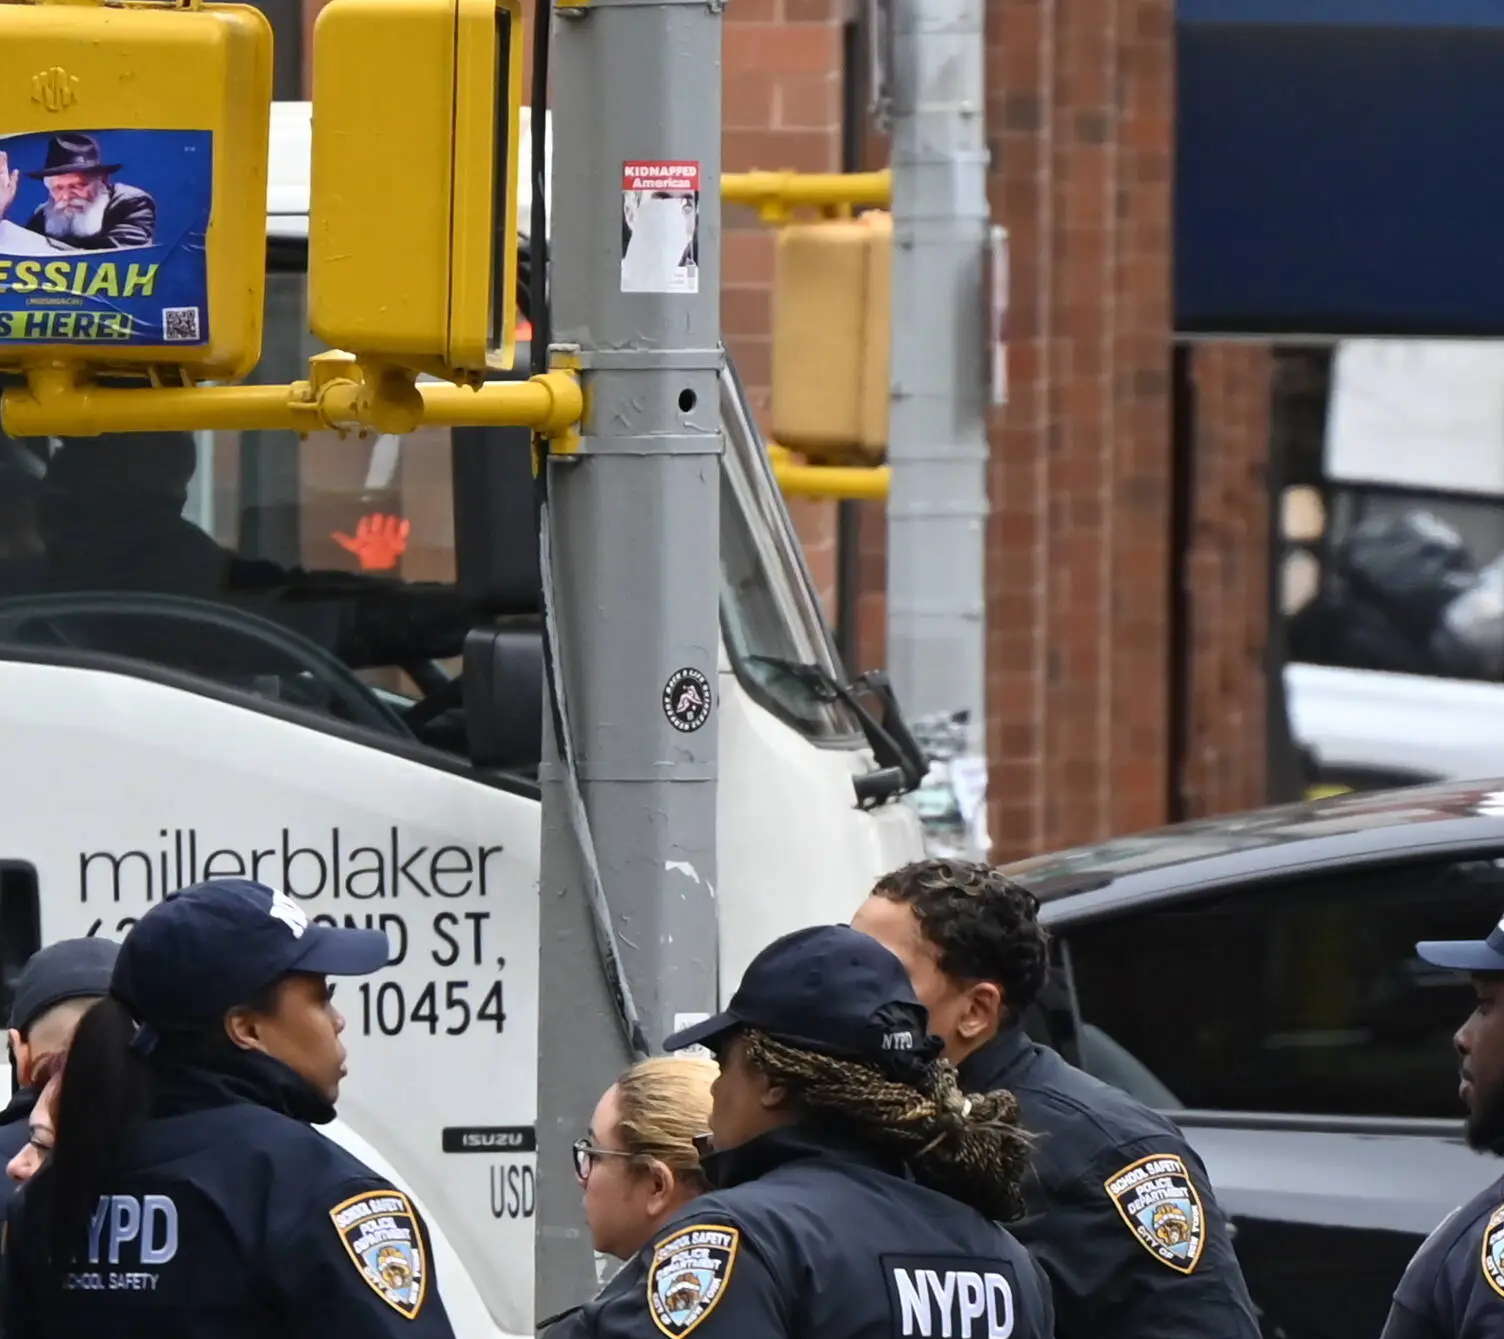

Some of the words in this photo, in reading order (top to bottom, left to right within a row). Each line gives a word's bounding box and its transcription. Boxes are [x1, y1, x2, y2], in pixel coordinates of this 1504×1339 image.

[624, 166, 697, 177] KIDNAPPED
[632, 177, 691, 188] American
[24, 312, 133, 340] HERE!
[80, 826, 503, 904] millerblaker
[431, 911, 506, 971] ST,
[358, 980, 507, 1036] 10454
[462, 1133, 523, 1146] ISUZU
[1110, 1168, 1148, 1193] SCHOOL
[1146, 1160, 1181, 1174] SAFETY
[1135, 1177, 1173, 1197] POLICE
[1127, 1187, 1189, 1215] DEPARTMENT
[87, 1195, 178, 1264] YPD
[692, 1231, 731, 1246] SAFETY
[1137, 1225, 1159, 1248] CITY
[109, 1273, 159, 1290] SAFETY
